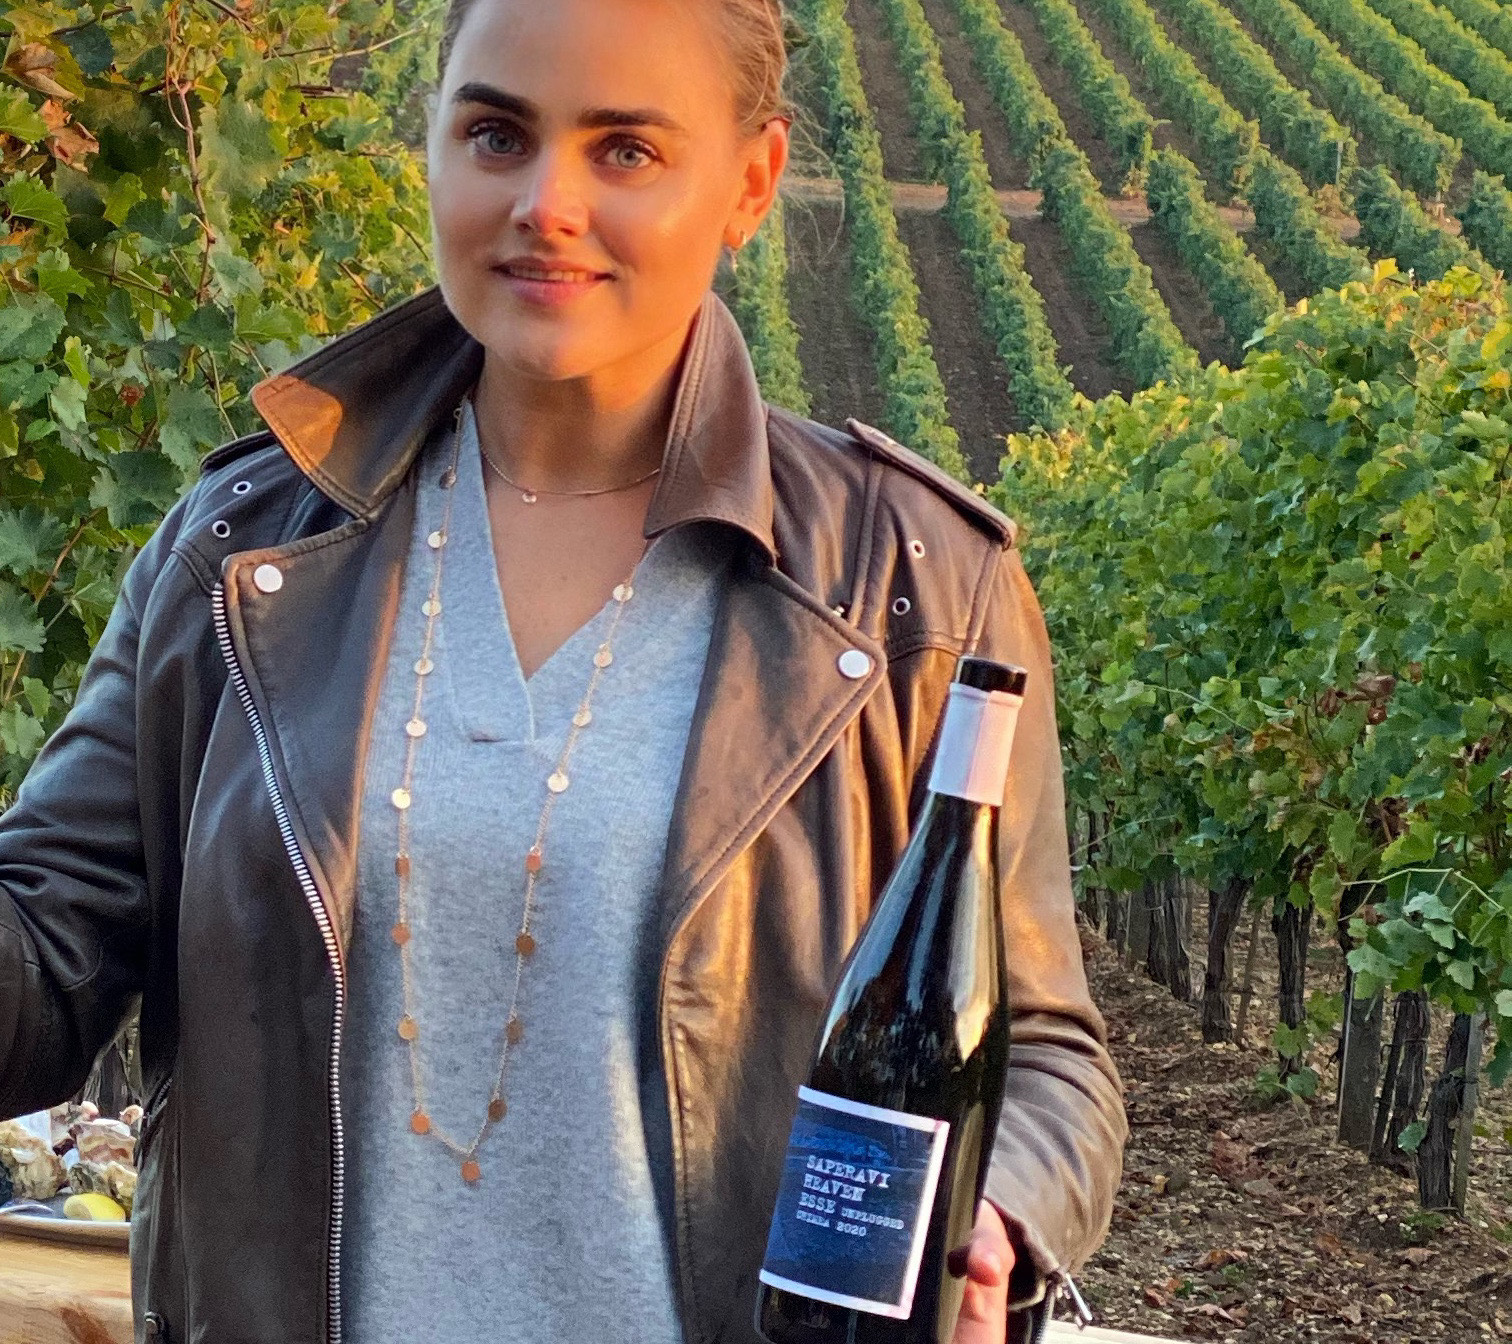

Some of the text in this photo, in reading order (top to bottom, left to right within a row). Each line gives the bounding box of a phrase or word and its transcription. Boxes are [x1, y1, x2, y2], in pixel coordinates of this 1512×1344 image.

[806, 1155, 891, 1189] SAPERAVI
[803, 1174, 866, 1202] HEAVEN
[799, 1192, 905, 1230] ESSE UNPLUGGED
[836, 1222, 867, 1237] 2020
